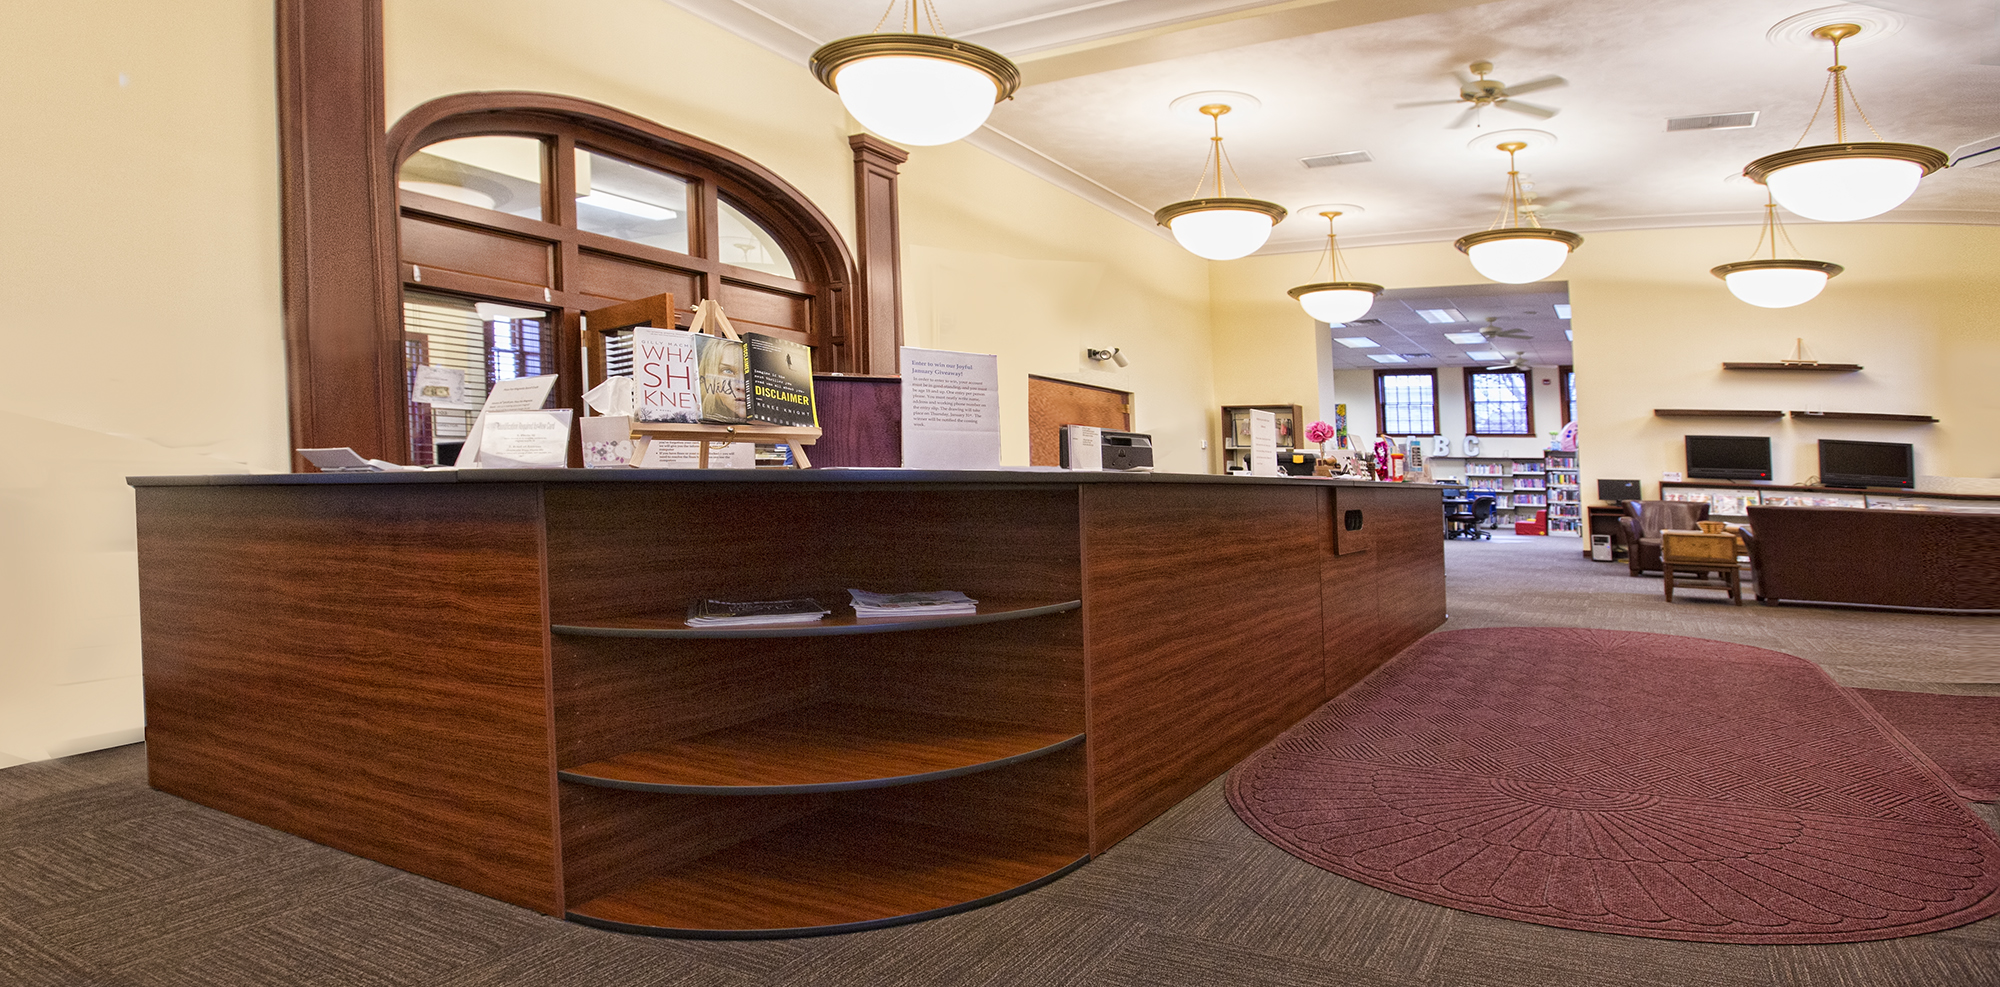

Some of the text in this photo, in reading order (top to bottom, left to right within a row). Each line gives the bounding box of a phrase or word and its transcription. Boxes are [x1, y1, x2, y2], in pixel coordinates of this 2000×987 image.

[641, 344, 693, 363] WHA
[643, 362, 691, 390] SH
[934, 369, 963, 377] Giveaway!
[700, 375, 736, 399] Wild
[754, 385, 810, 406] DISCLAIMER
[783, 408, 810, 416] KNIGHT
[1433, 435, 1450, 457] B
[1463, 435, 1480, 457] C
